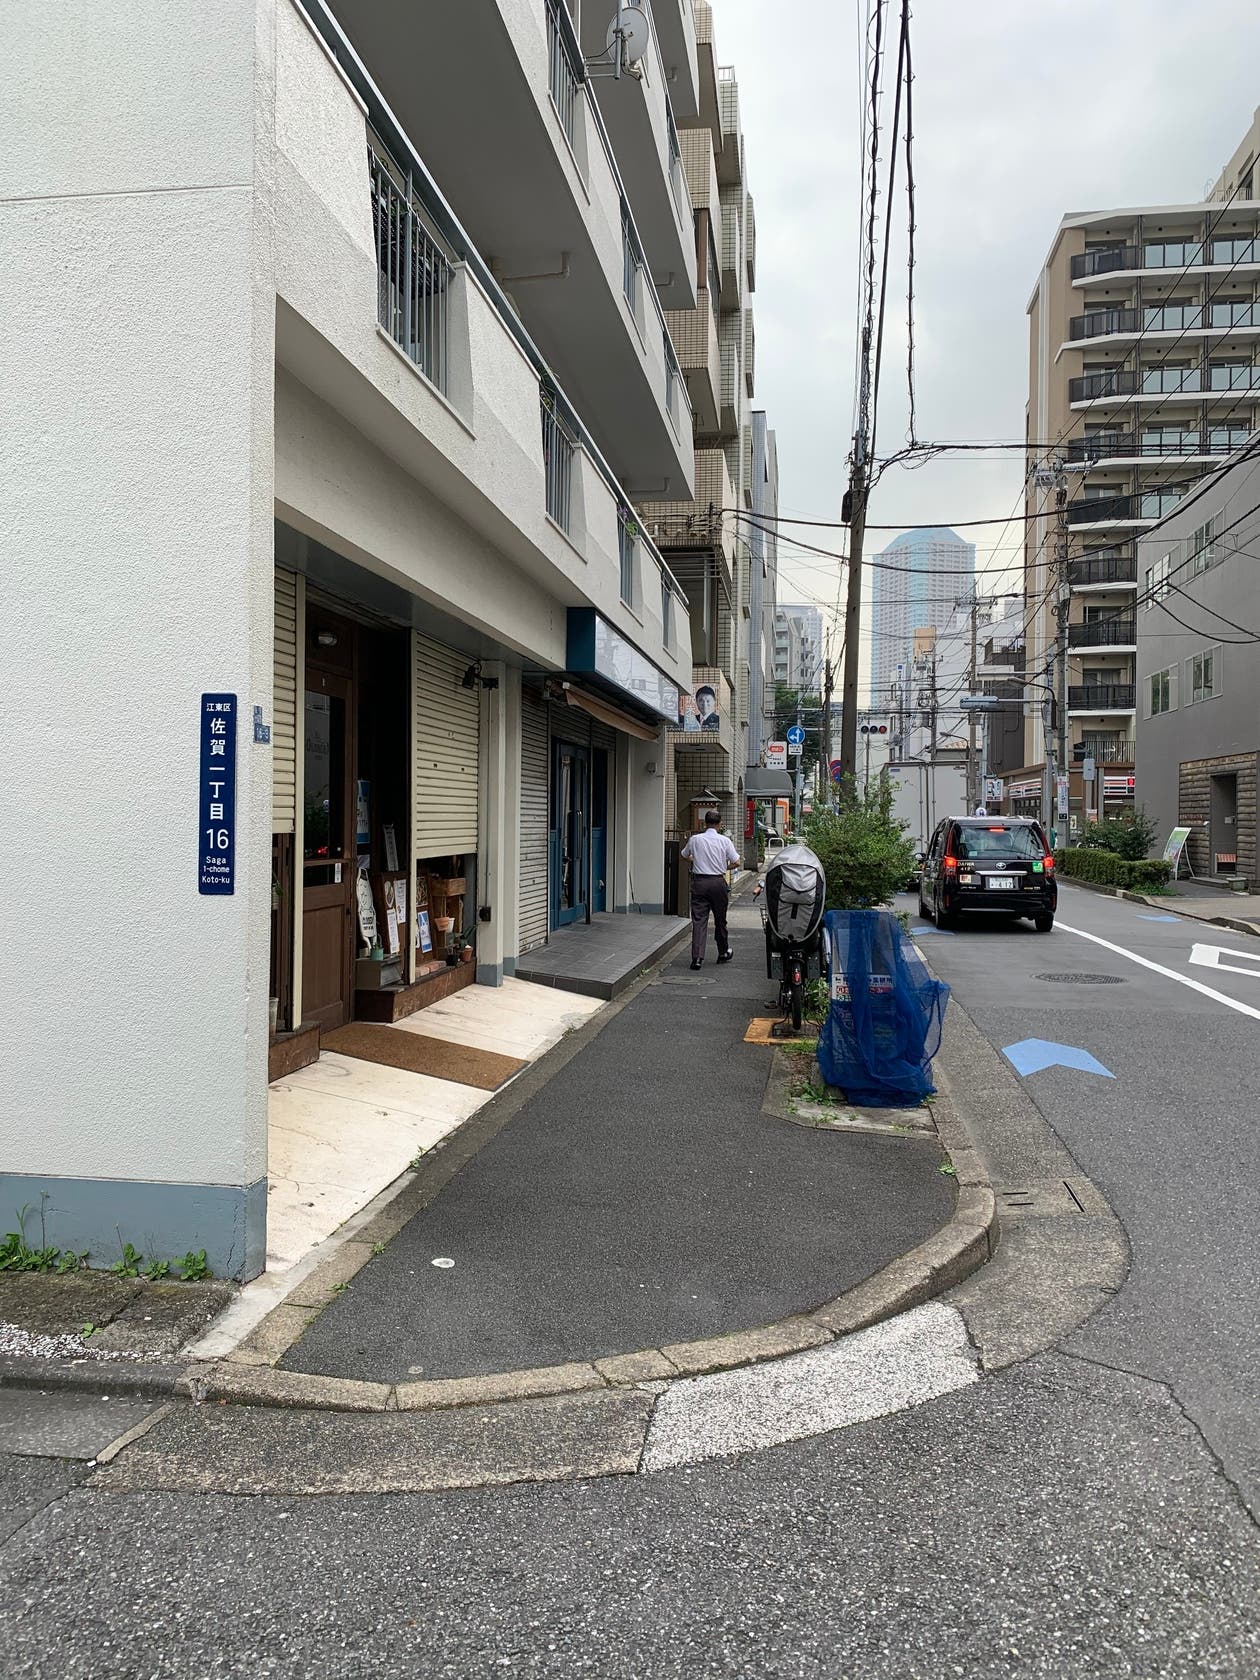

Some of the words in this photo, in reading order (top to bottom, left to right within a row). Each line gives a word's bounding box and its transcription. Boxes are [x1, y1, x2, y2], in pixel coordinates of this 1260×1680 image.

[206, 702, 232, 712] 江東区
[209, 717, 226, 821] 佐賀一丁目
[206, 828, 229, 849] 16
[205, 856, 227, 865] Saga
[203, 865, 230, 873] 1-chome
[202, 875, 230, 884] Koto-ku
